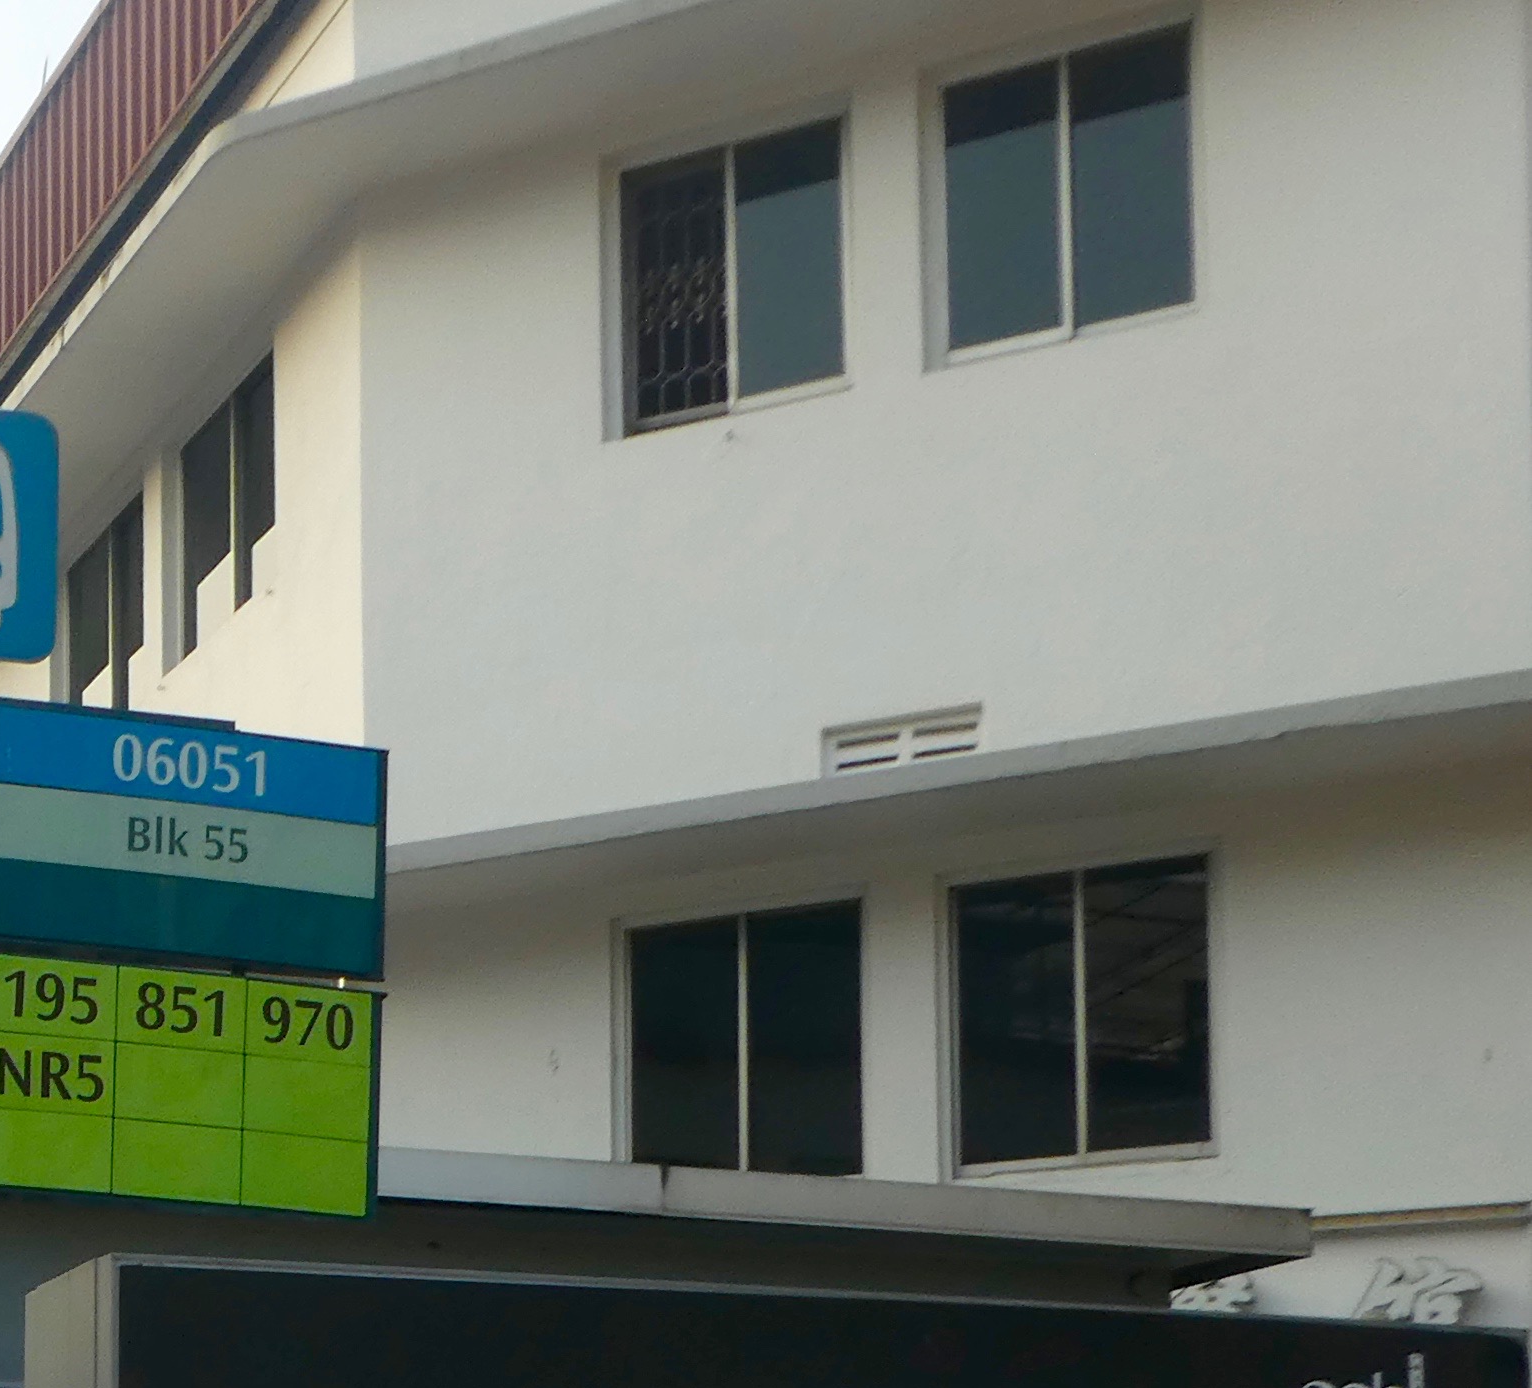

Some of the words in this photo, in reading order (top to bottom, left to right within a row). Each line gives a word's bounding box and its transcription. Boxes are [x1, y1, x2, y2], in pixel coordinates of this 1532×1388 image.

[113, 734, 267, 797] 06051
[127, 816, 188, 858] Blk
[204, 824, 249, 863] 55
[4, 970, 99, 1025] 195
[136, 981, 225, 1037] 851
[263, 996, 354, 1051] 970
